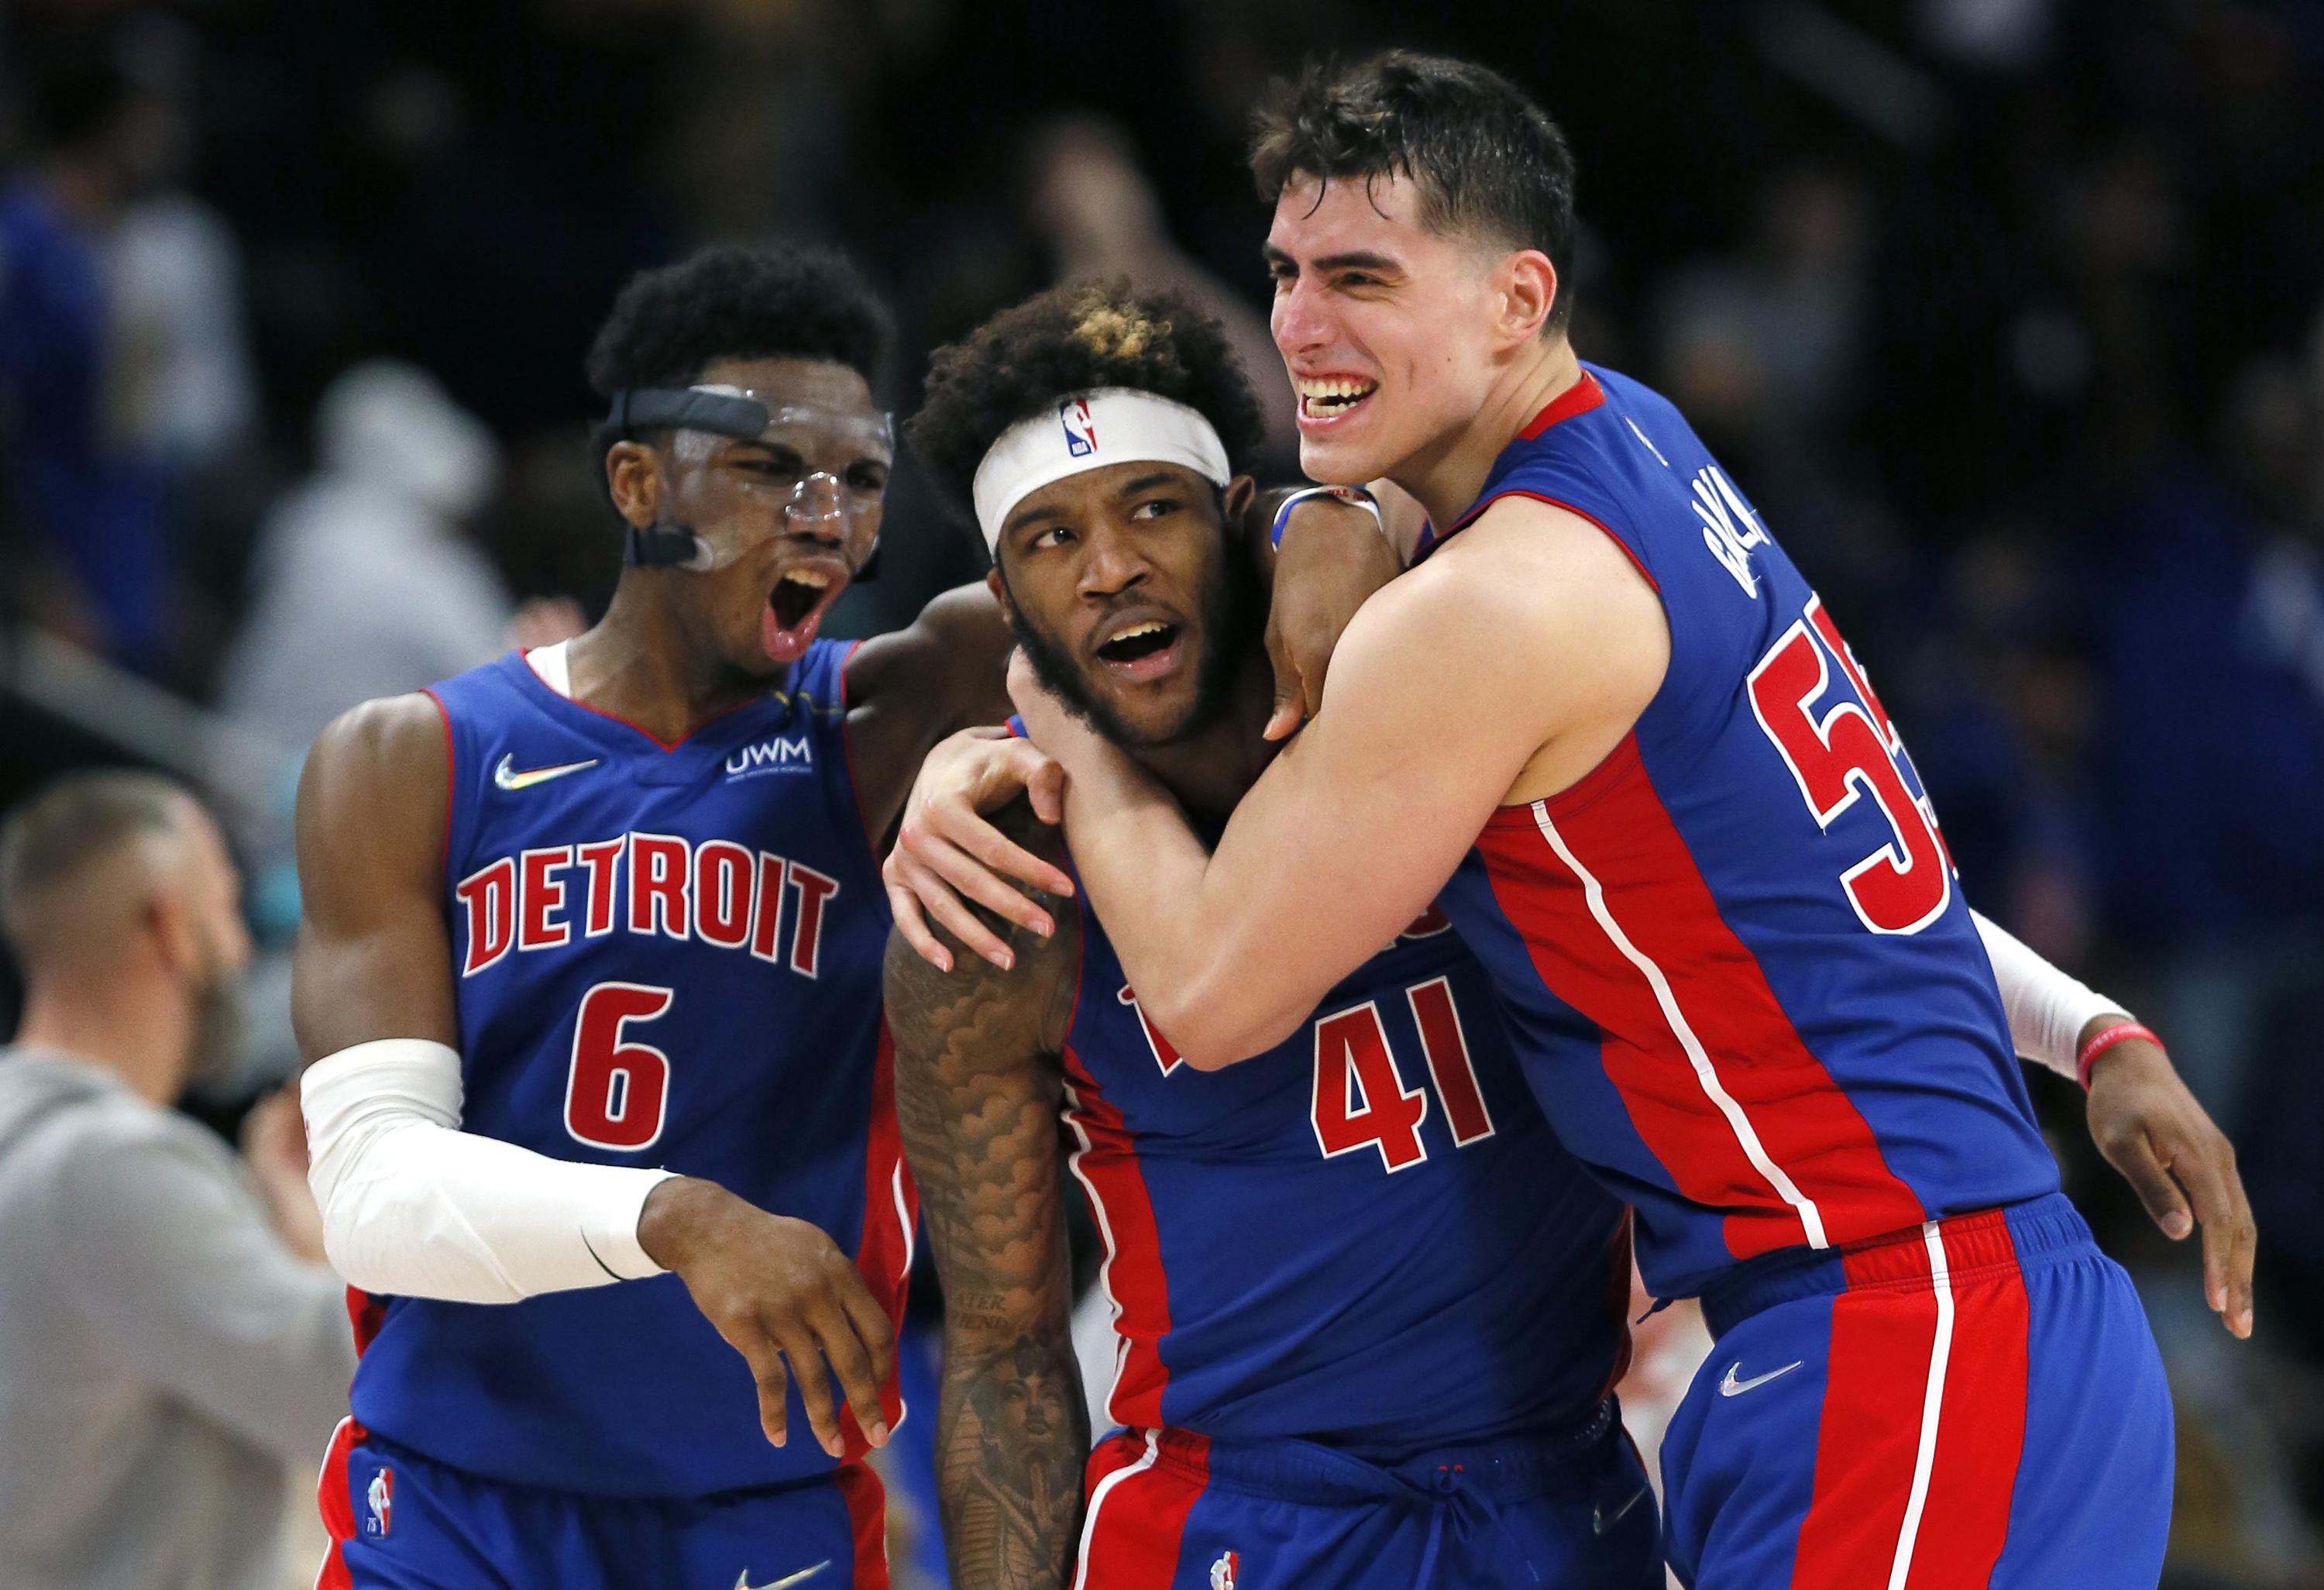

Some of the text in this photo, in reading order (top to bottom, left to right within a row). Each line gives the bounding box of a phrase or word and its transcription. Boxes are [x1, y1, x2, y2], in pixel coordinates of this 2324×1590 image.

[726, 735, 811, 775] UWM
[456, 831, 841, 979] DETROIT
[563, 981, 673, 1152] 6
[1311, 975, 1495, 1174] 41
